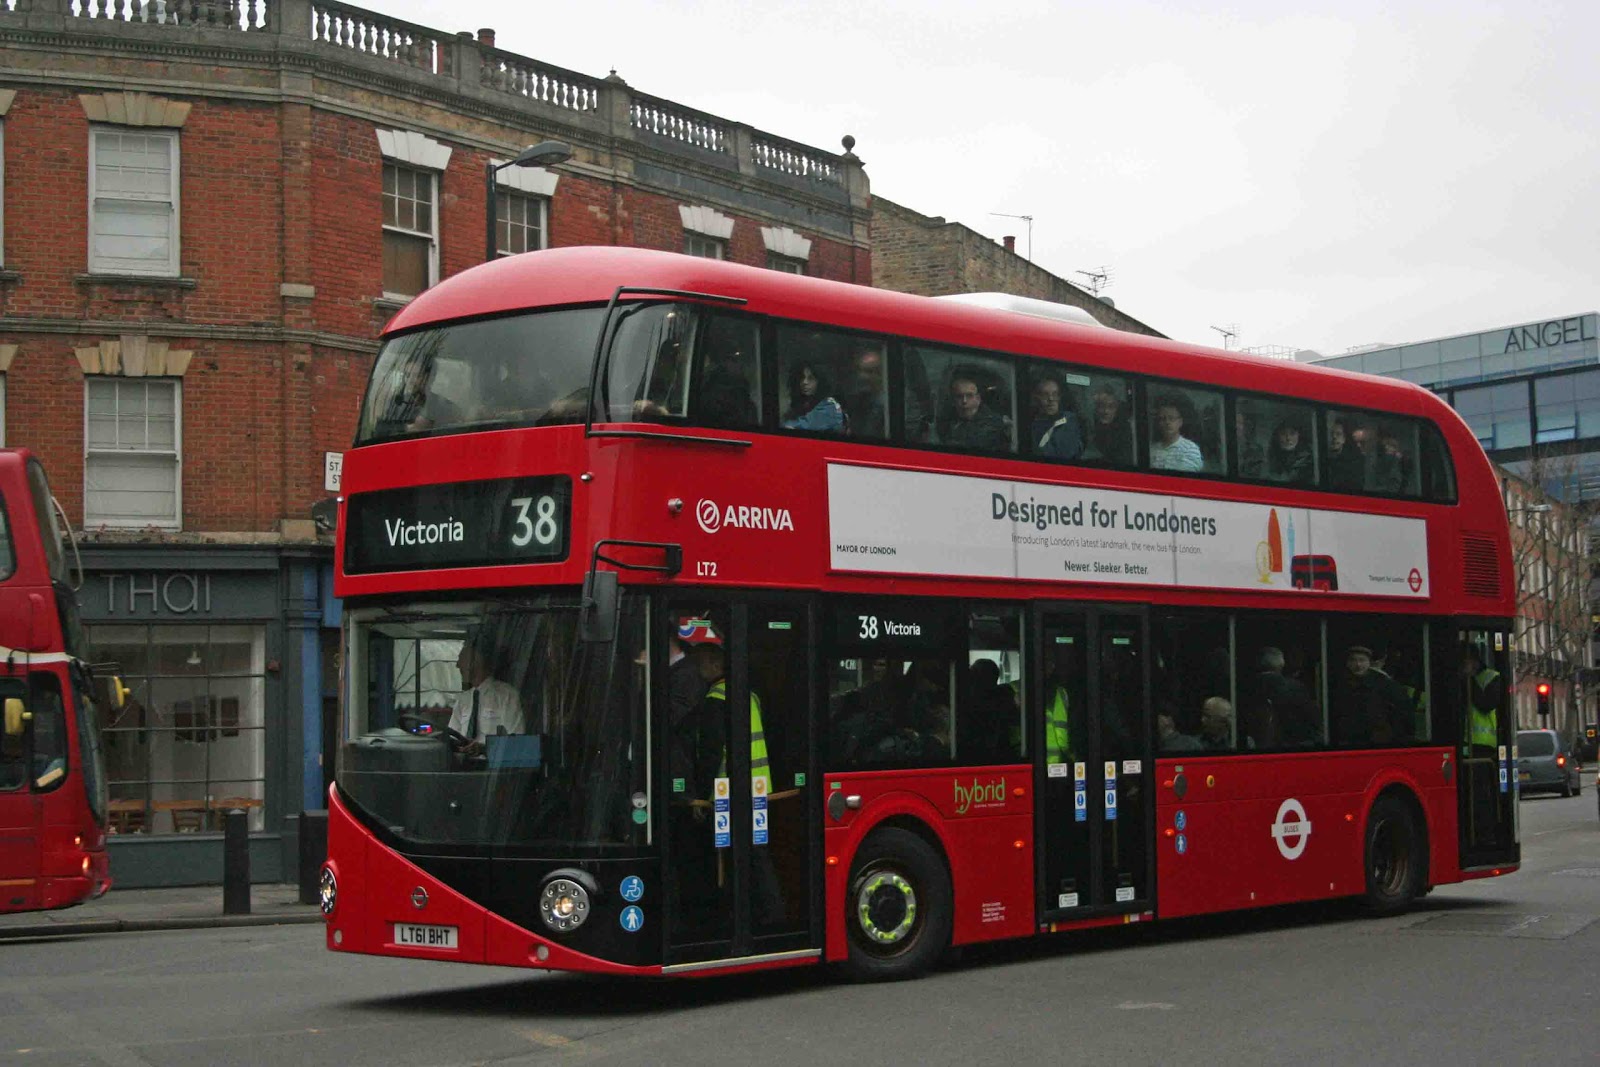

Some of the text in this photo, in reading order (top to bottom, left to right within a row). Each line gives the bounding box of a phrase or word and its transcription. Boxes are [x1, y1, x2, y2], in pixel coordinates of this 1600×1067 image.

[1503, 315, 1595, 354] ANGEL
[385, 495, 557, 546] Victoria 38
[723, 505, 794, 532] ARRIVA
[991, 492, 1217, 536] Designed for Londoners
[836, 544, 897, 556] MAYOR OF LONDON
[696, 561, 718, 577] LT2
[1124, 562, 1149, 575] Better.
[858, 615, 921, 639] 38 Victoria
[954, 776, 1006, 814] hybrid
[401, 926, 450, 945] LT61 BHT
